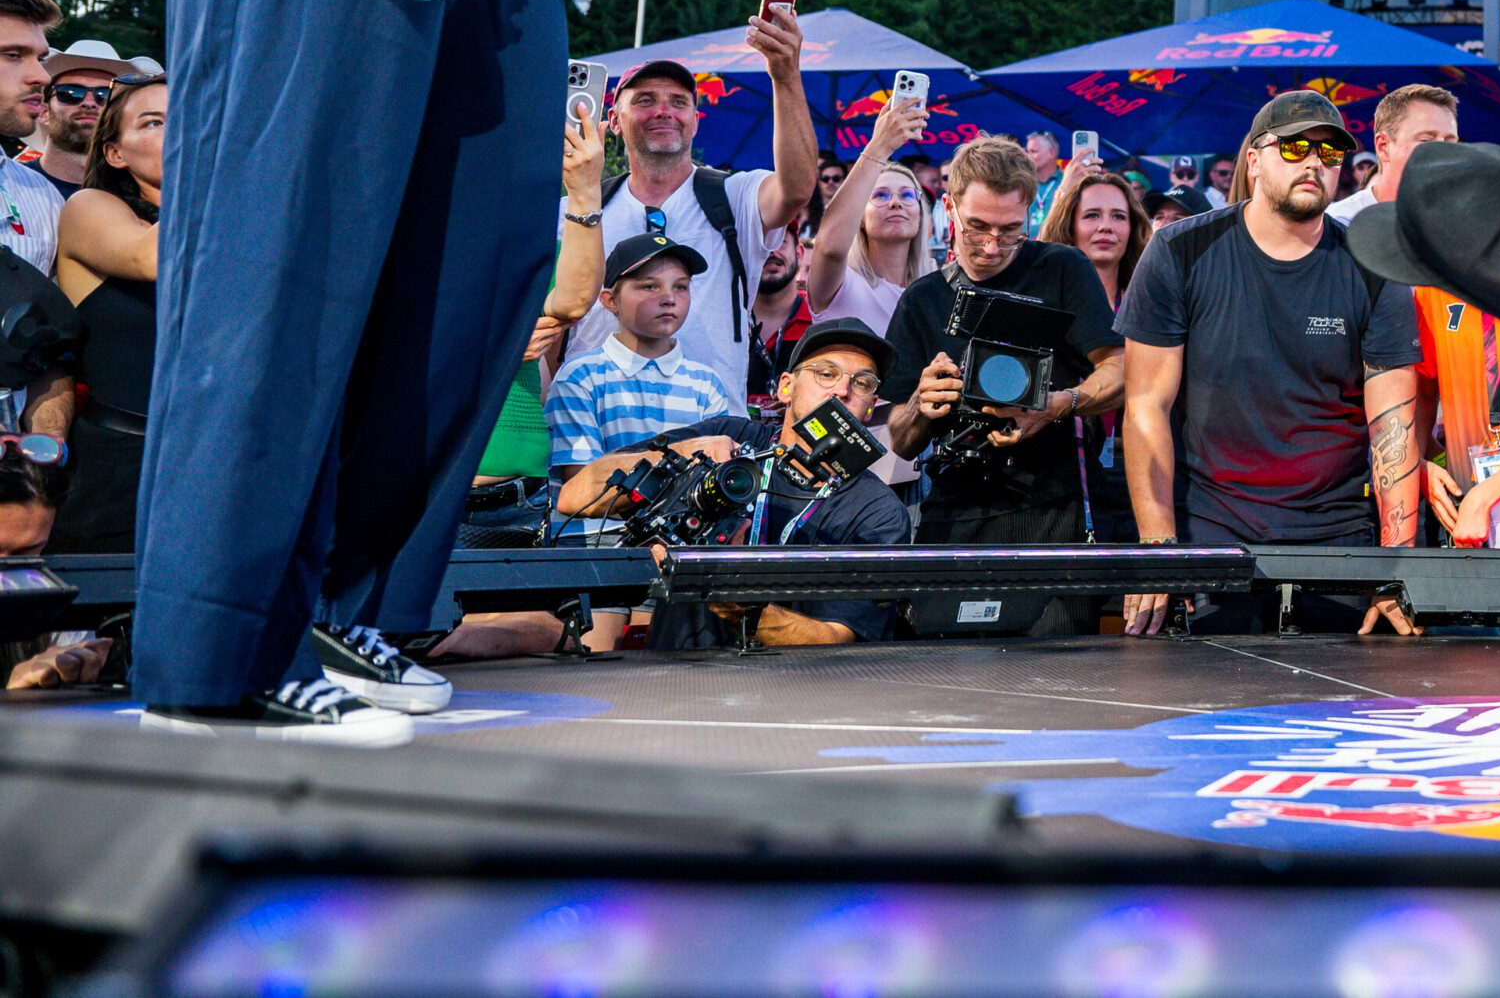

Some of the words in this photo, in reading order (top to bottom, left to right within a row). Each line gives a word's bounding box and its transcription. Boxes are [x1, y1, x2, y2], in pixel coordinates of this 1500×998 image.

[1156, 45, 1247, 60] Red
[1248, 44, 1339, 58] Bull
[1446, 303, 1466, 321] 1
[831, 410, 851, 431] RED
[851, 431, 872, 453] PRO
[837, 426, 855, 444] 5.0
